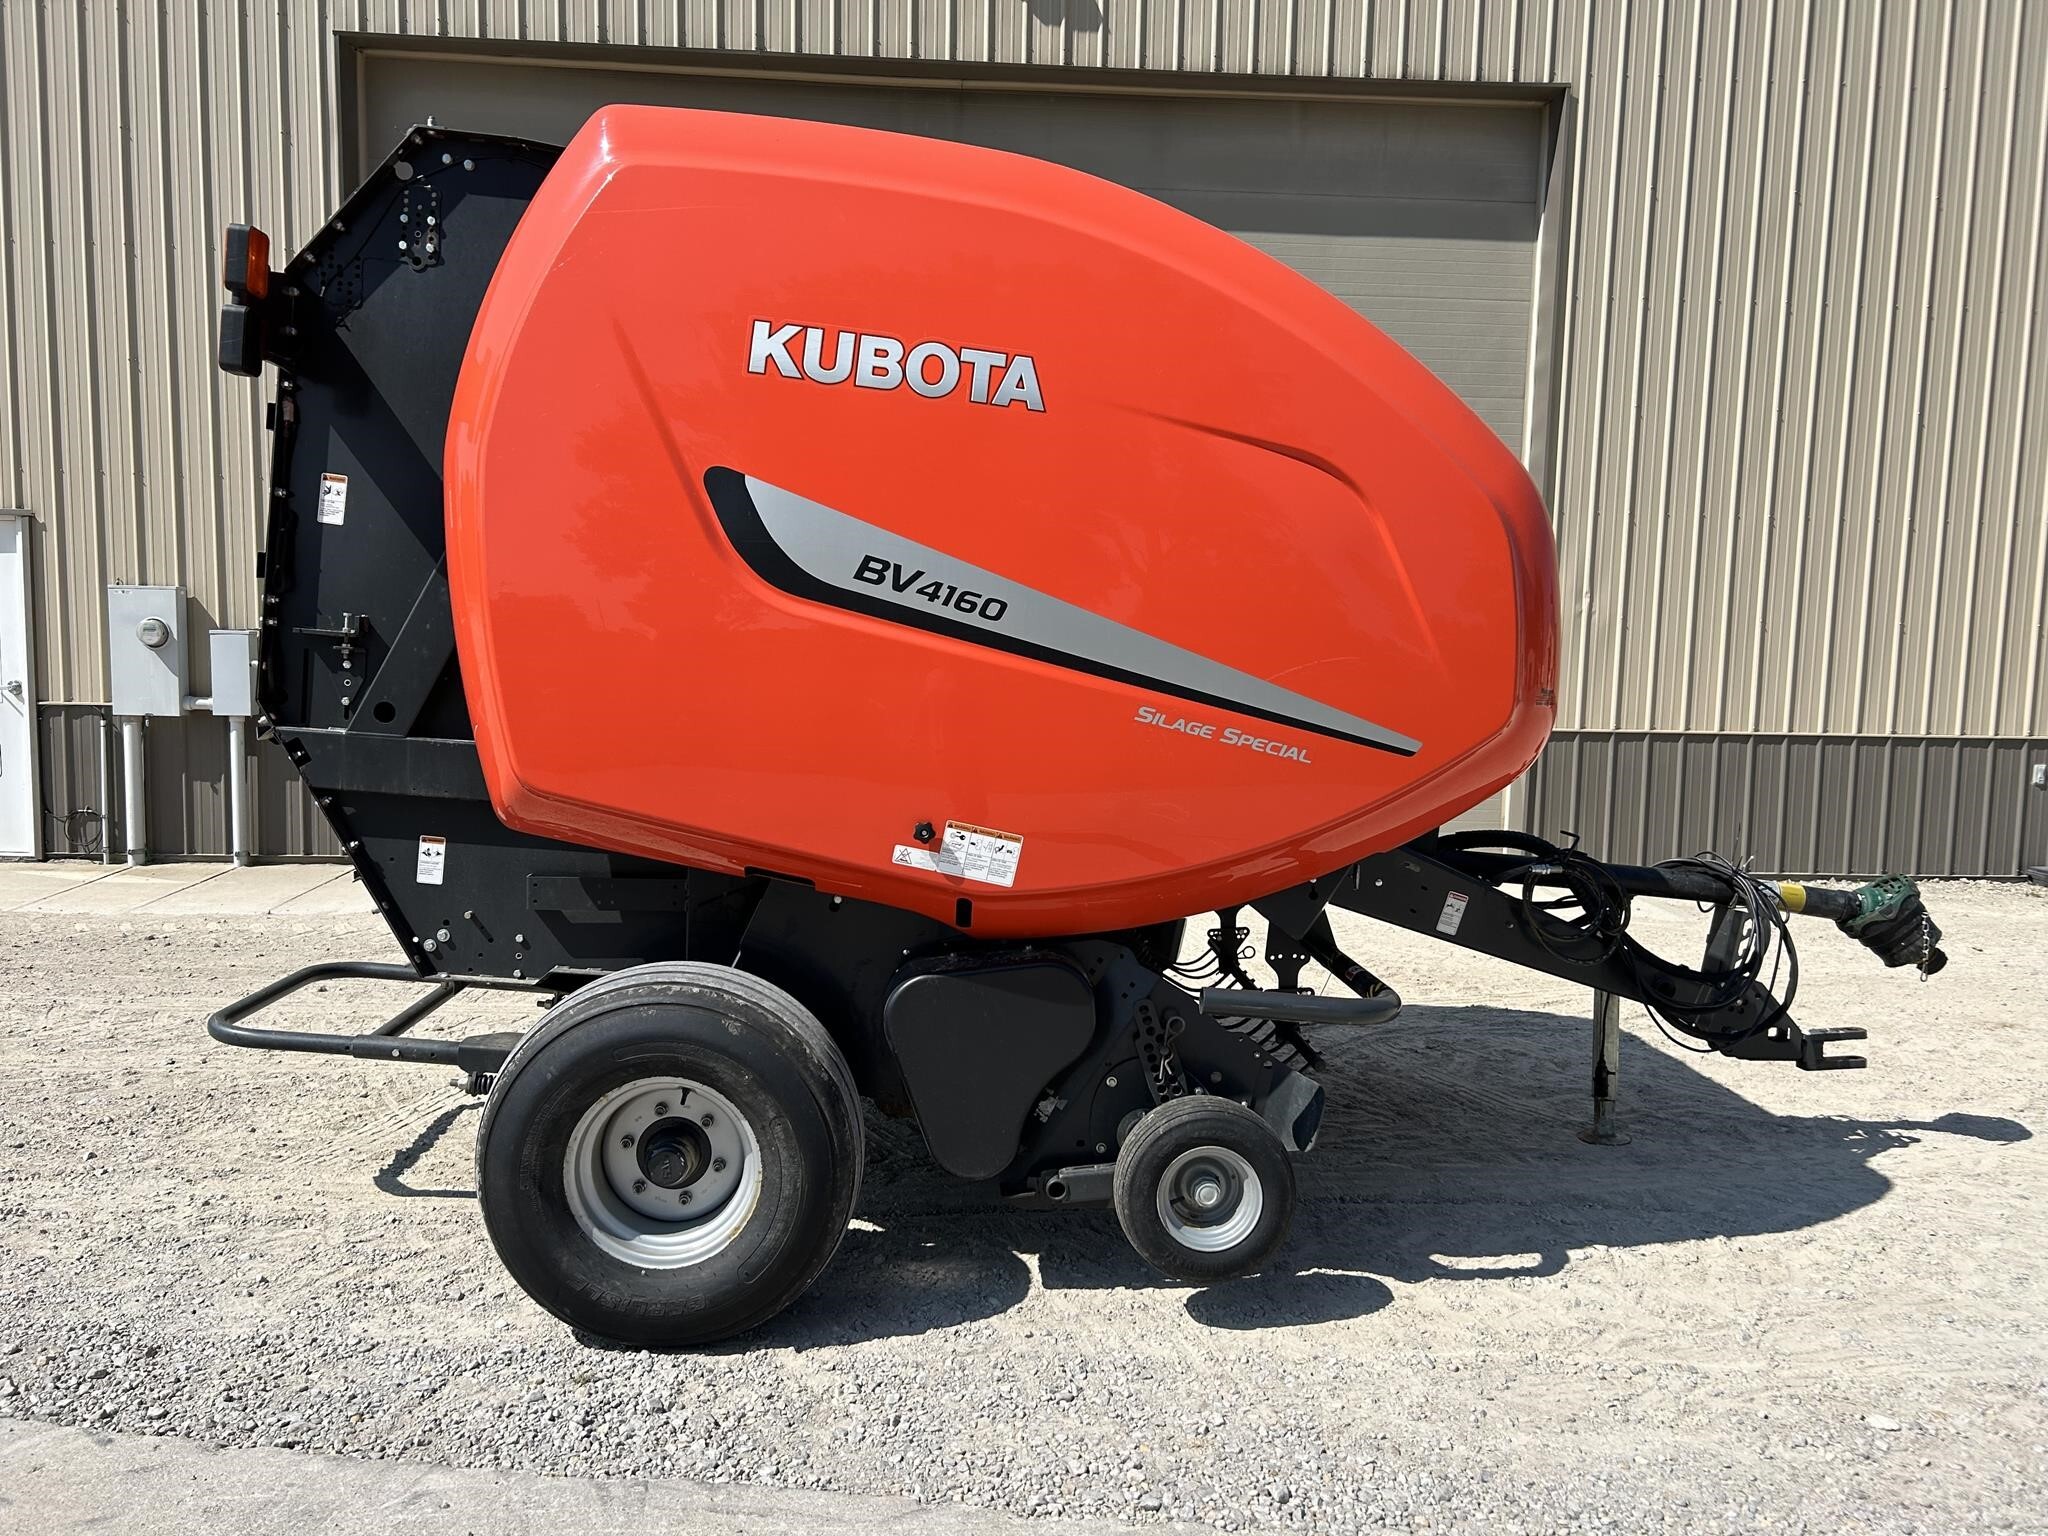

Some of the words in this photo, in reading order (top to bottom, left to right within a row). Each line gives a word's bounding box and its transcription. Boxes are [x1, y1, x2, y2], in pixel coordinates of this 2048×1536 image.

[747, 319, 1046, 412] KUBOTA
[853, 554, 1008, 622] BV4160
[1134, 706, 1216, 739] SILAGE
[1219, 727, 1312, 764] SPECIAL
